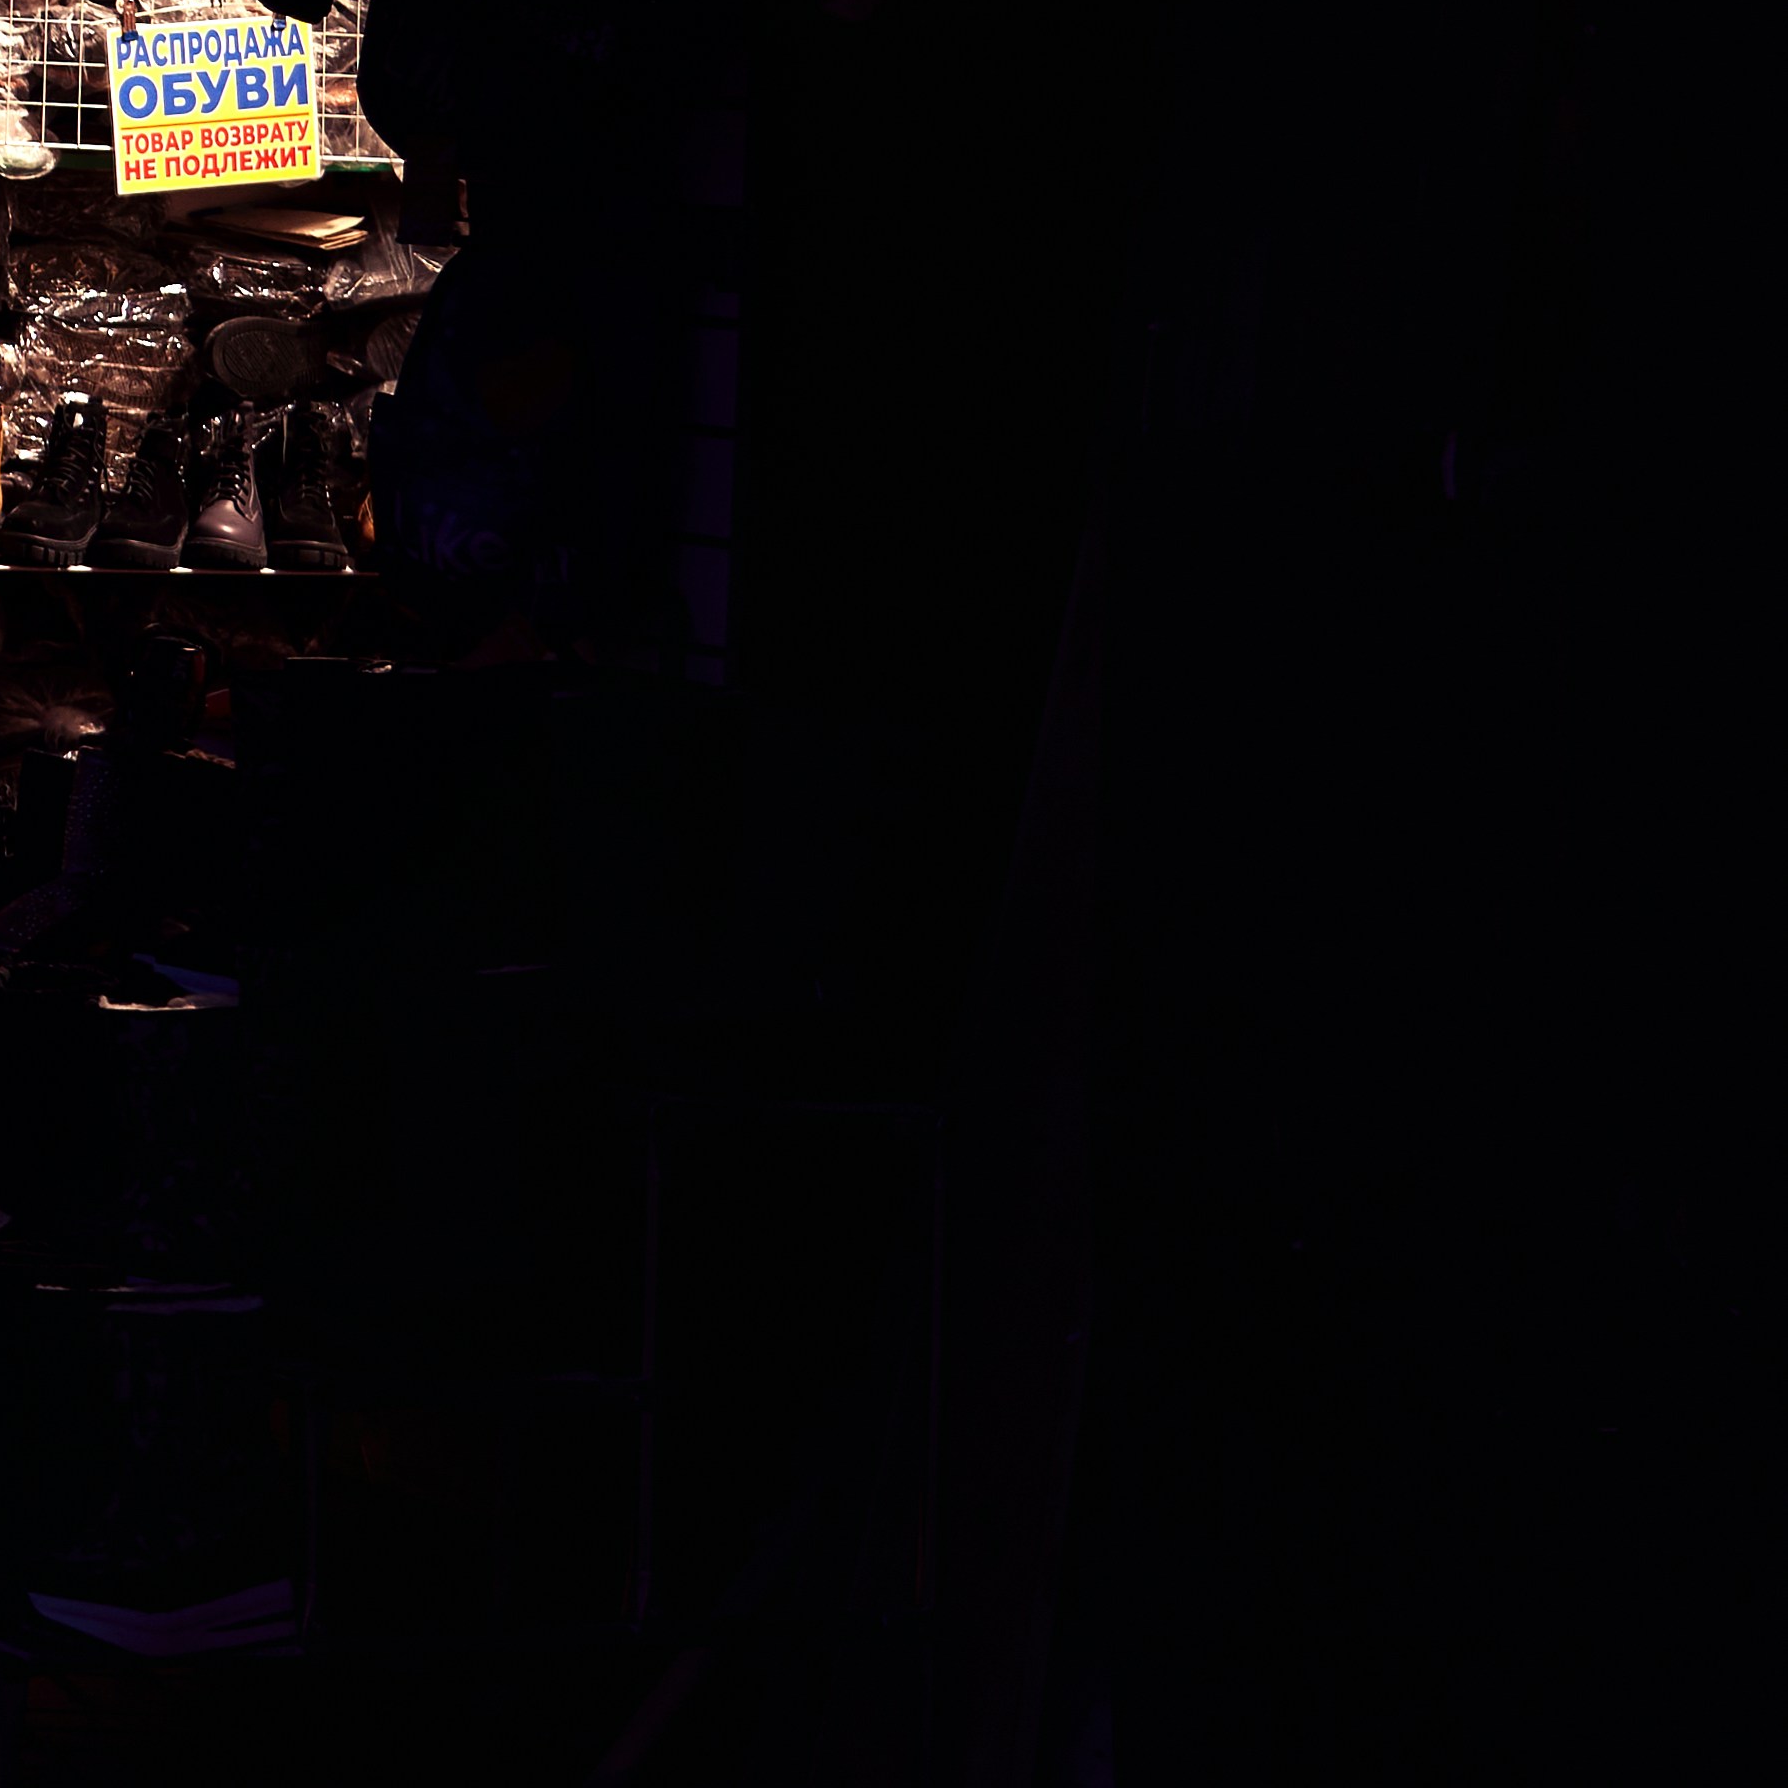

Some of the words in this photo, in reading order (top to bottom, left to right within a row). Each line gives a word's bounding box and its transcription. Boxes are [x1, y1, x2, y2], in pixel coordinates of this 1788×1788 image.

[116, 23, 305, 70] РАСПРОДАЖА
[118, 62, 310, 119] ОБУВИ
[122, 129, 194, 155] ТОВАР
[200, 119, 310, 149] ВОЗВРАТУ
[124, 159, 157, 181] НЕ
[165, 145, 312, 179] ПОДЛЕЖИТ
